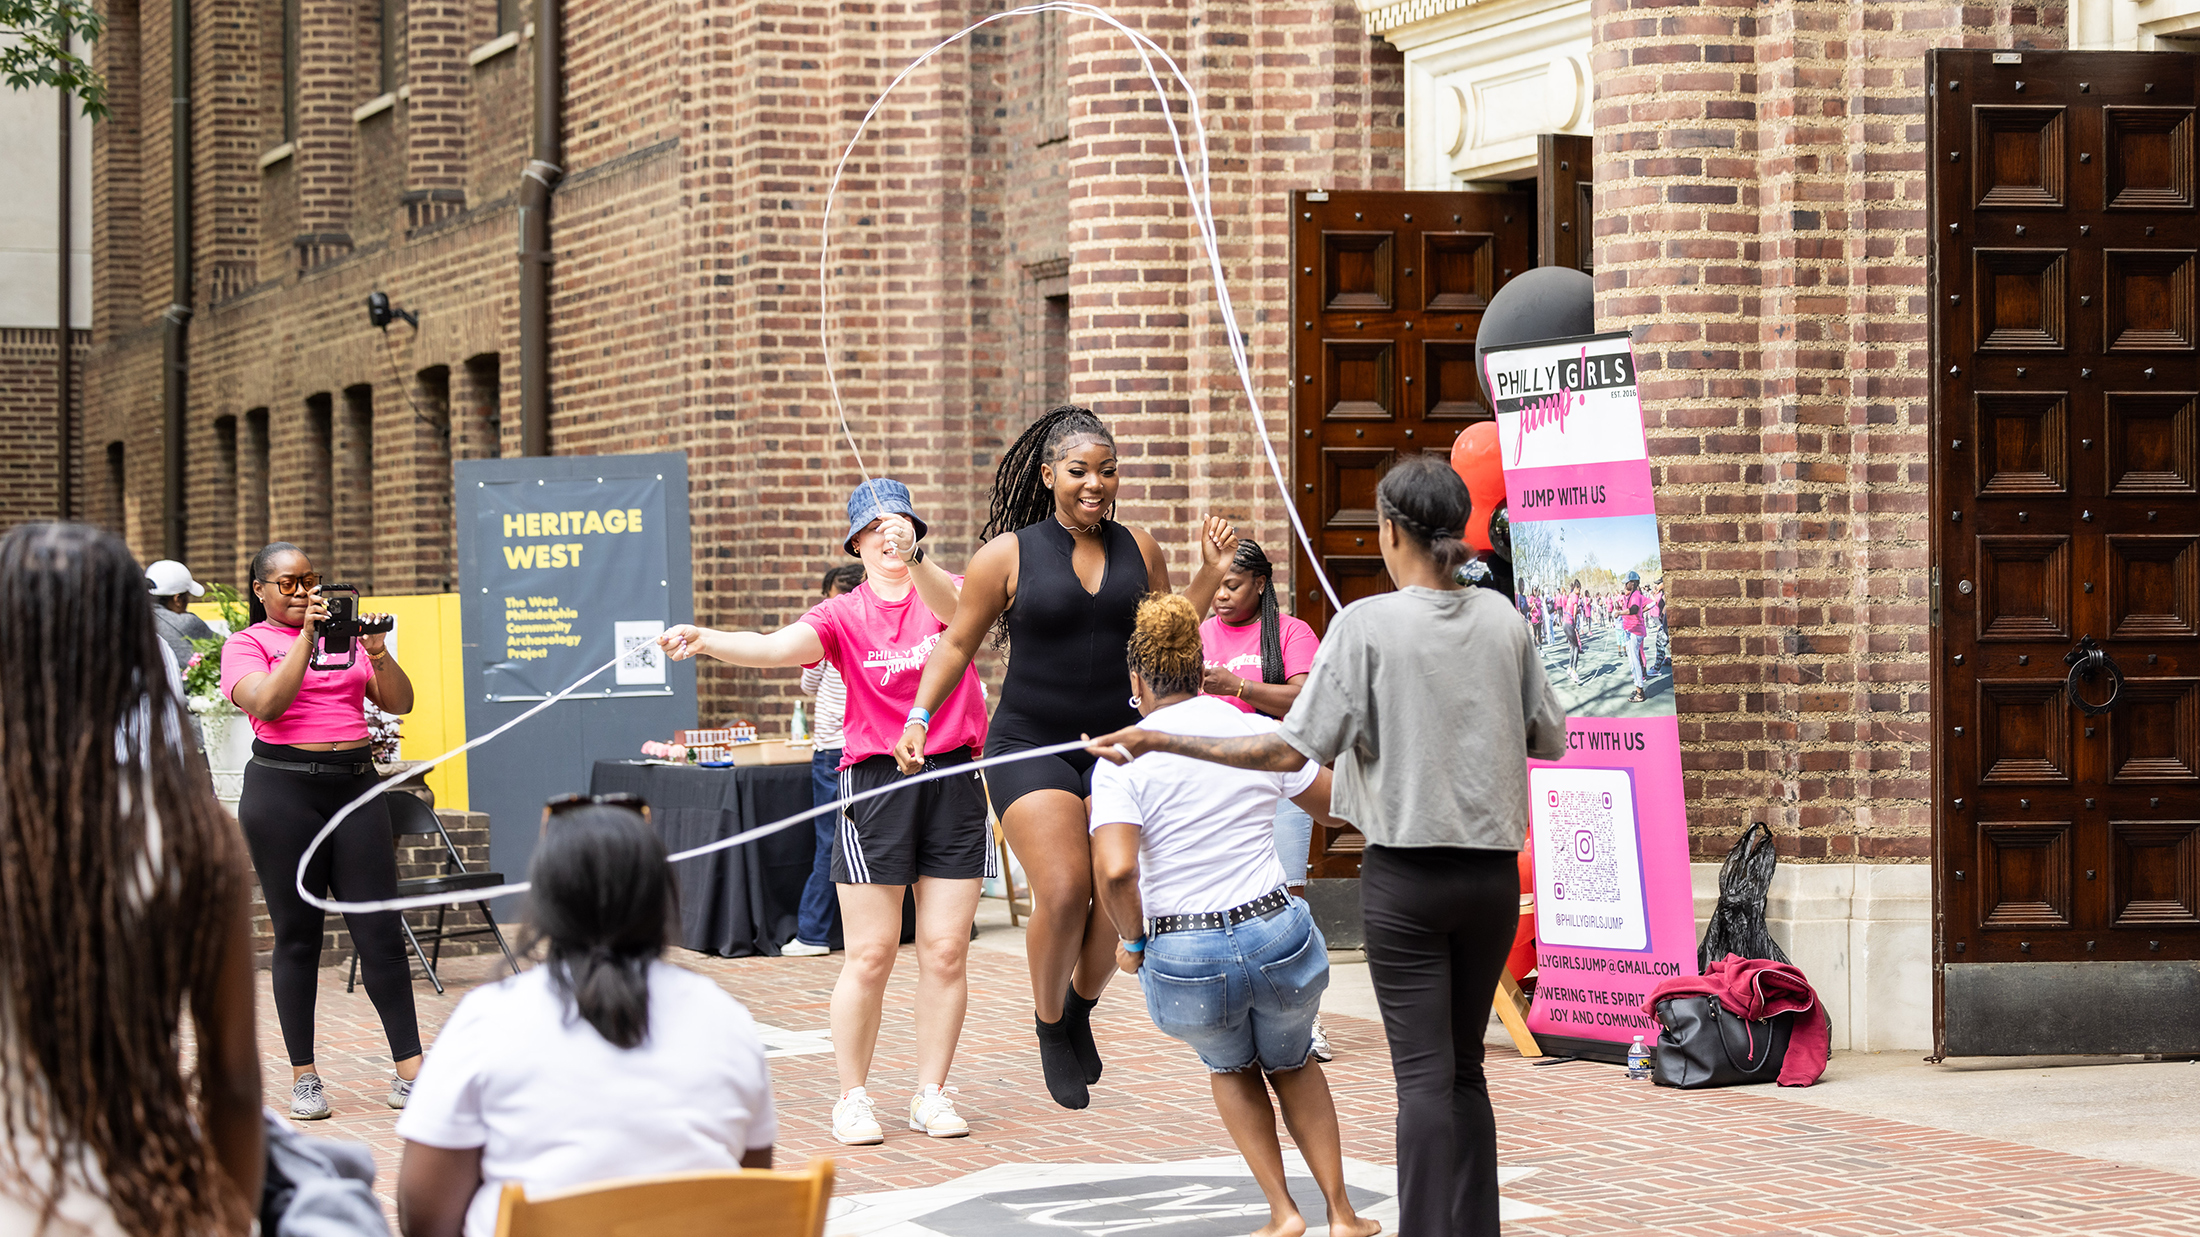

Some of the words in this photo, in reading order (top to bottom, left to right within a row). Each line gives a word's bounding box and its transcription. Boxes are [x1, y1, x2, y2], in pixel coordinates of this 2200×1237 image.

[1497, 366, 1555, 396] PHILLY
[1611, 390, 1621, 398] EST.
[1622, 389, 1636, 397] 2016
[1521, 489, 1554, 508] JUMP
[1557, 486, 1587, 506] WITH
[1590, 485, 1606, 504] US
[503, 508, 643, 537] HERITAGE
[503, 543, 584, 569] WEST
[504, 596, 527, 609] The
[528, 596, 559, 607] West
[505, 607, 579, 622] Philadelphia
[505, 620, 572, 634] Community
[506, 633, 582, 647] Archaeology
[507, 647, 548, 661] Project
[868, 650, 911, 661] PHILLY
[1587, 731, 1621, 750] WITH
[1623, 732, 1645, 751] US
[1555, 912, 1624, 929] @PHILLYGIRLSJUMP
[1538, 954, 1680, 976] LLYGIRLSJUMP@GMAIL.COM
[1588, 990, 1609, 1005] THE
[1611, 992, 1645, 1007] SPIRIT
[1550, 1008, 1568, 1022] JOY
[1572, 1010, 1594, 1024] AND
